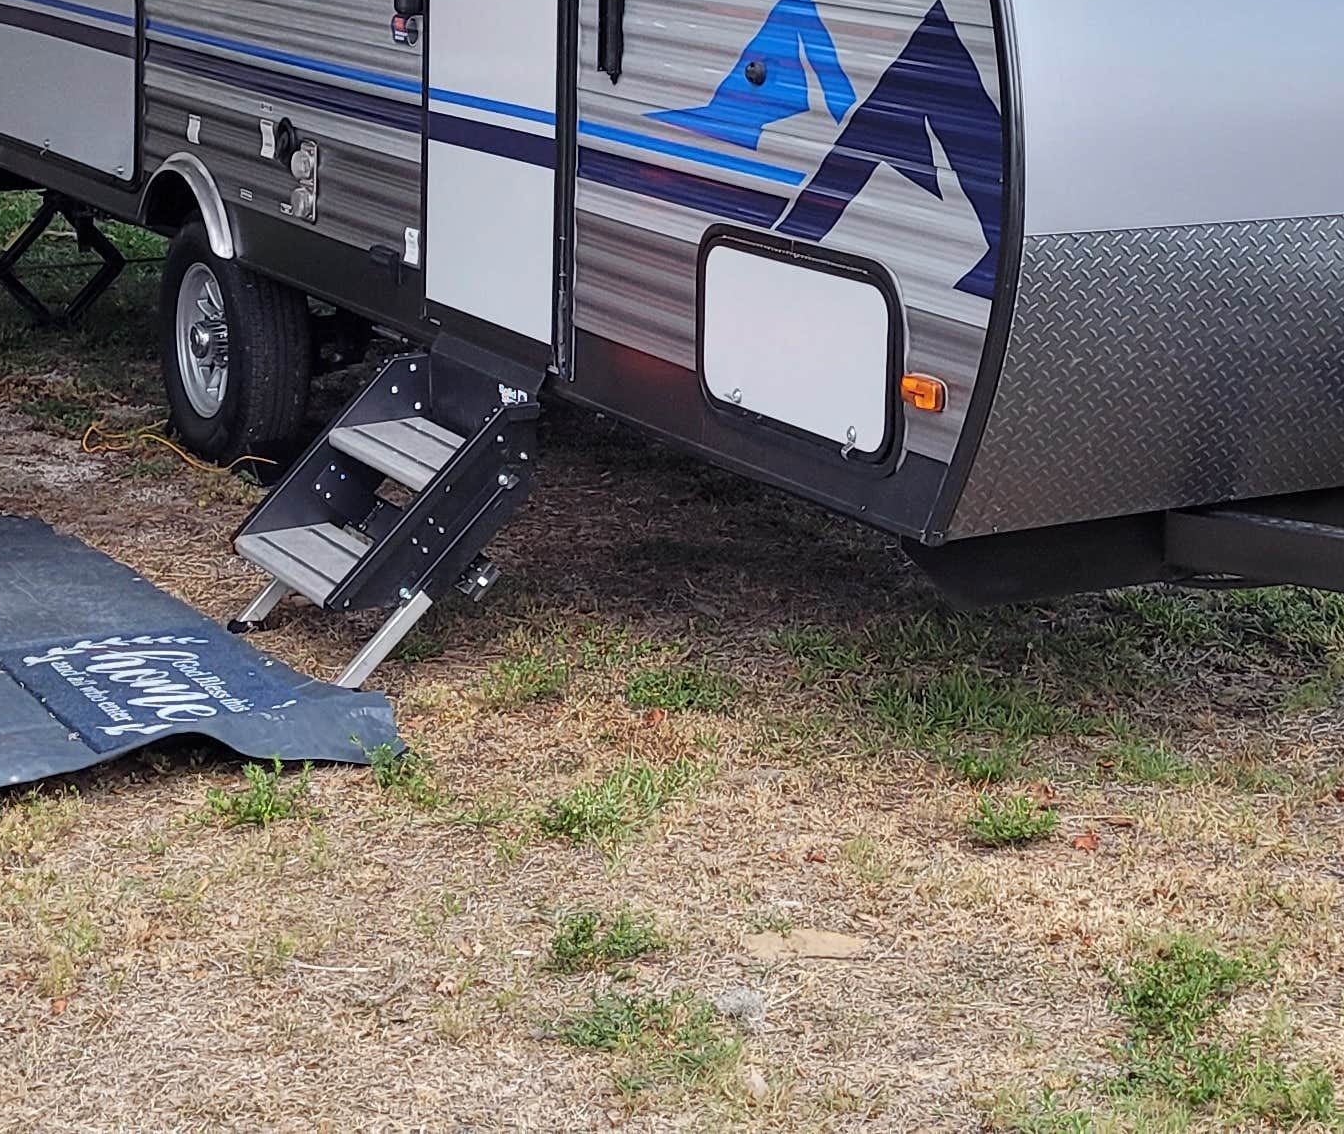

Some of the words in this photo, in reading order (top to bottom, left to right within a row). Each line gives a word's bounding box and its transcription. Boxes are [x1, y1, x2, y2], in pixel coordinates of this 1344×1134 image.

[50, 661, 88, 677] and
[172, 660, 212, 677] God
[191, 676, 232, 699] Bless
